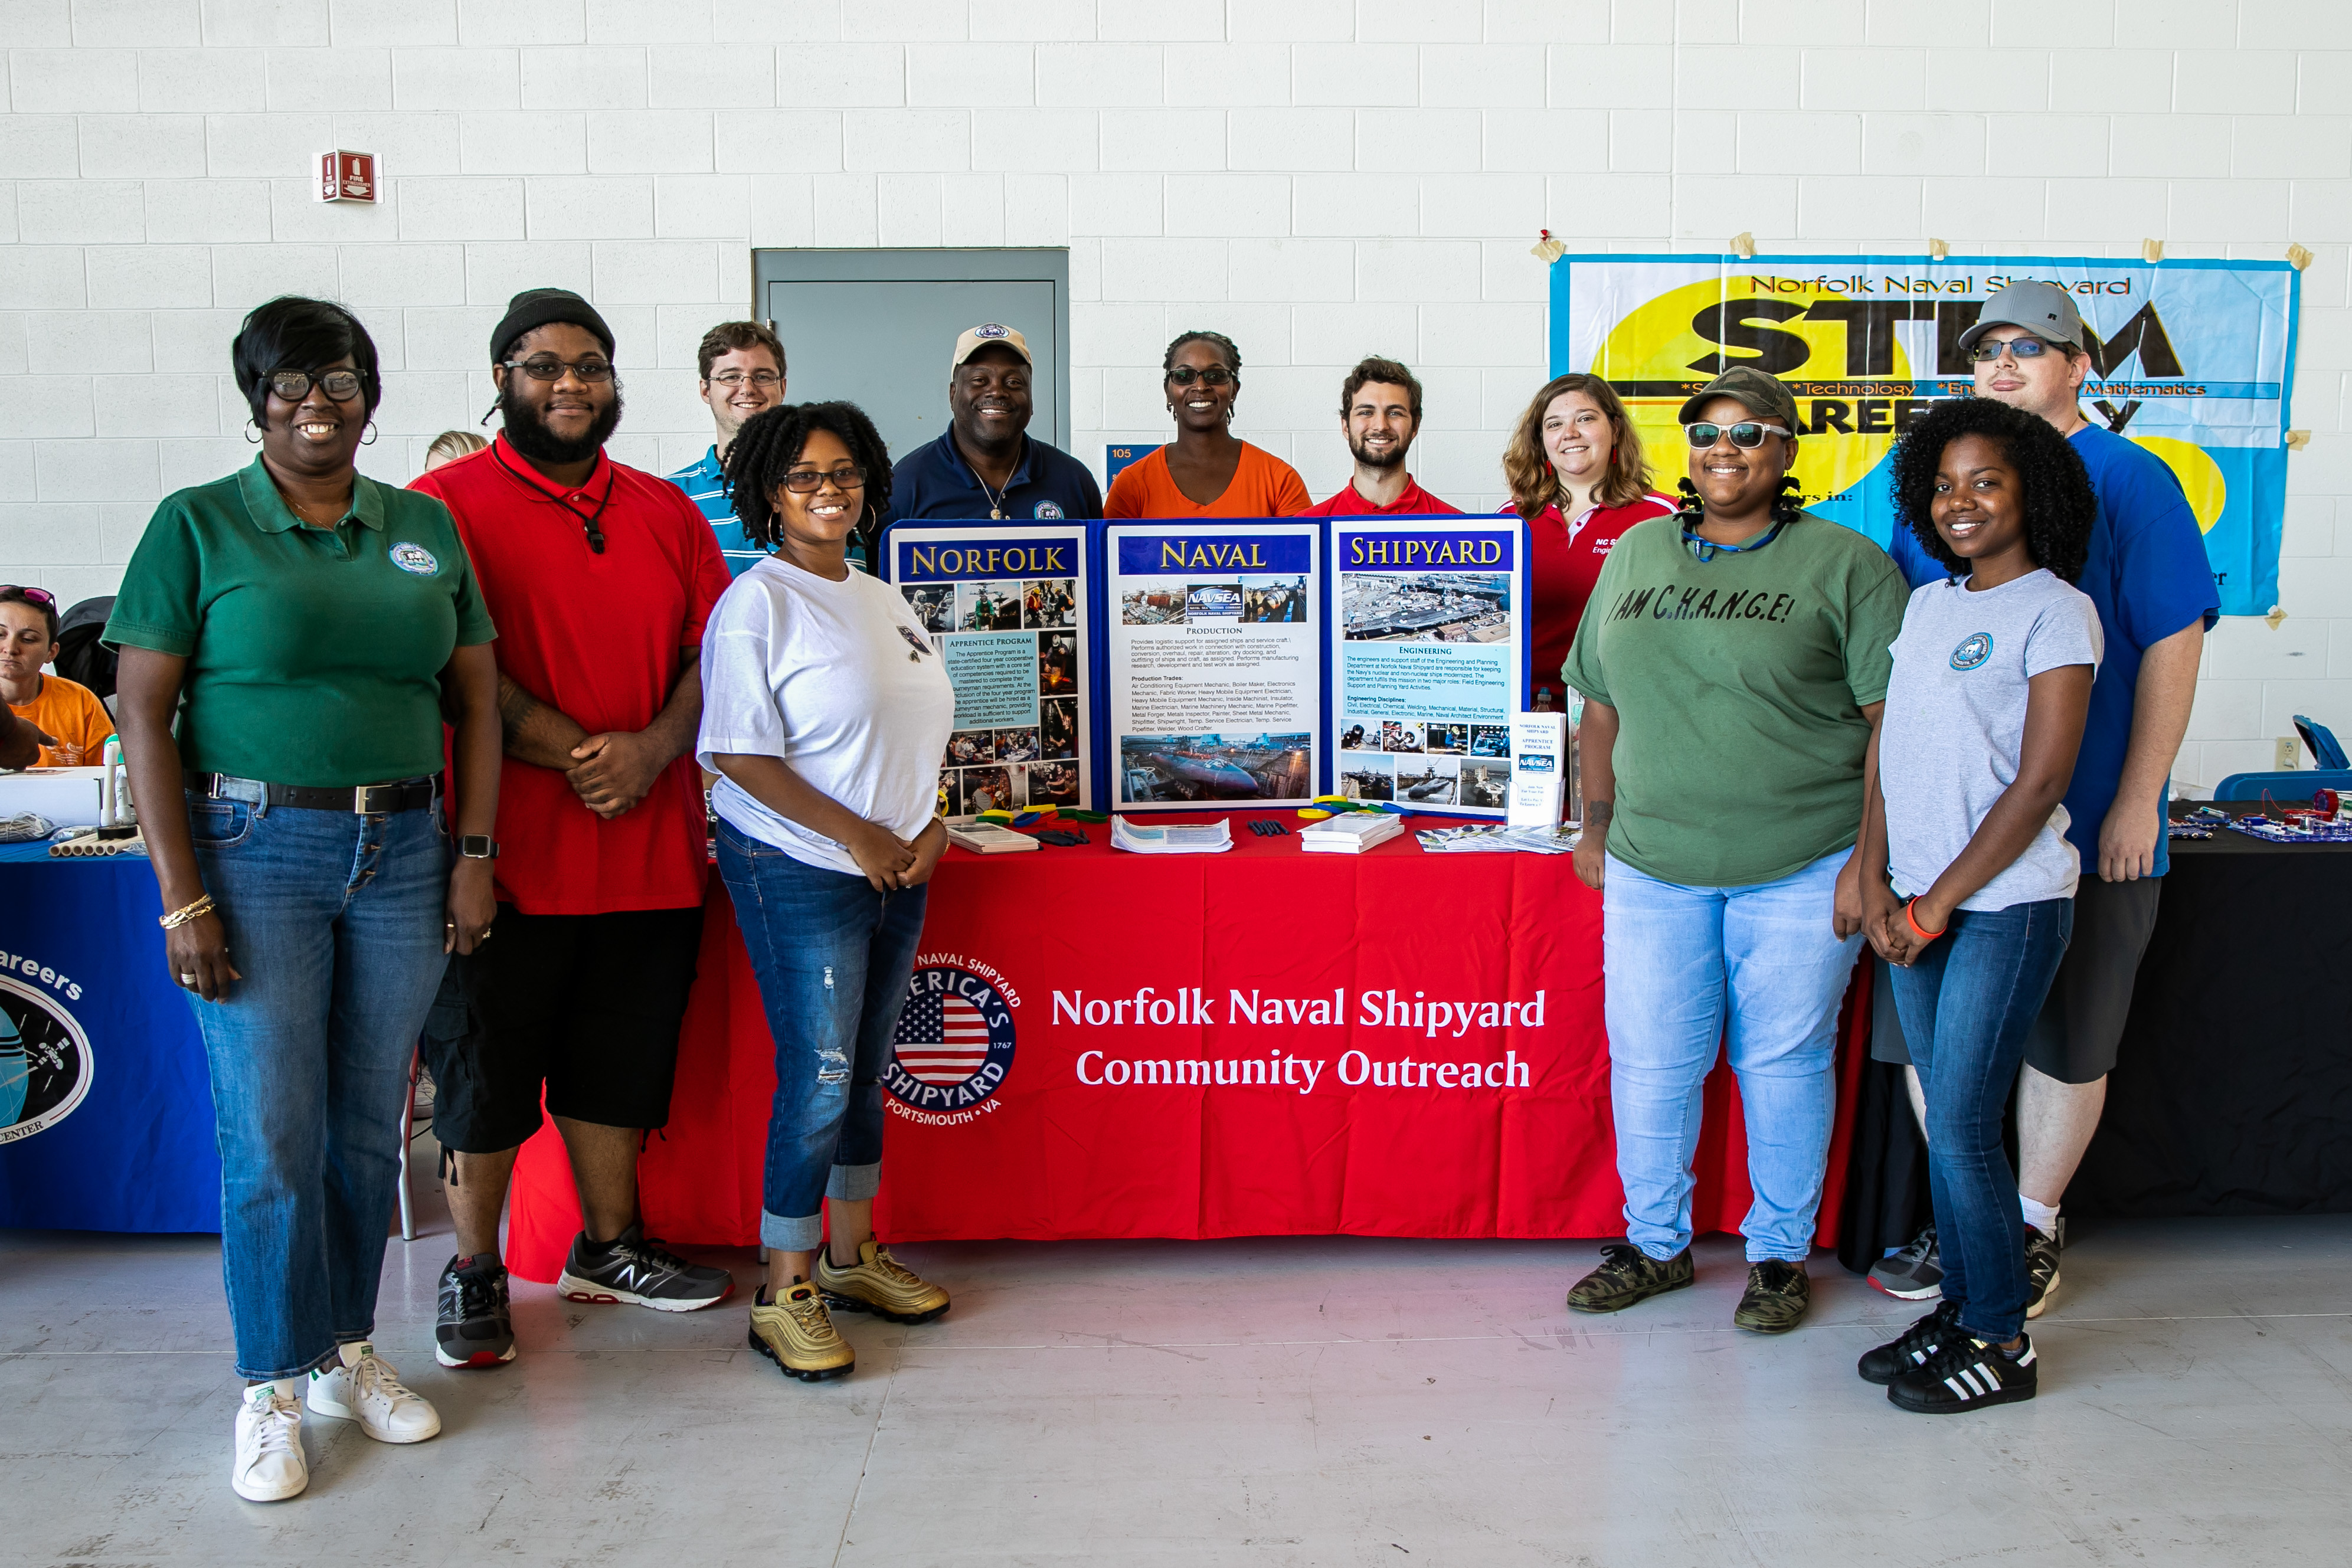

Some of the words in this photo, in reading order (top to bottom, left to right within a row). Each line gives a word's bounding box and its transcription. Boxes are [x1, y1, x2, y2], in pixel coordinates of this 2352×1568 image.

[1750, 275, 1874, 294] Norfolk
[1885, 275, 1972, 294] Naval
[1985, 276, 2131, 295] Syard
[2084, 382, 2206, 396] Mathematics
[1113, 449, 1131, 458] 105
[1826, 491, 1853, 501] in:
[911, 546, 1067, 576] NORFOLK
[1161, 541, 1267, 569] NAVAL
[1351, 536, 1502, 565] SHIPYARD
[1188, 593, 1240, 603] NAVSEA
[1614, 587, 1656, 621] AM
[1653, 584, 1795, 623] C.H.A.N.G.E!
[917, 952, 964, 967] NAVAL
[967, 958, 1021, 1009] SHIPYARD
[906, 971, 1009, 1028] ERICA'S
[1052, 987, 1215, 1025] Norfolk
[1229, 987, 1344, 1025] Naval
[1360, 990, 1545, 1038] Shipyard
[882, 1062, 1003, 1107] SHIPYARD
[1077, 1049, 1325, 1095] Community
[1337, 1050, 1530, 1088] Outreach
[885, 1098, 973, 1125] PORTSMOUTH
[981, 1099, 1002, 1113] VA
